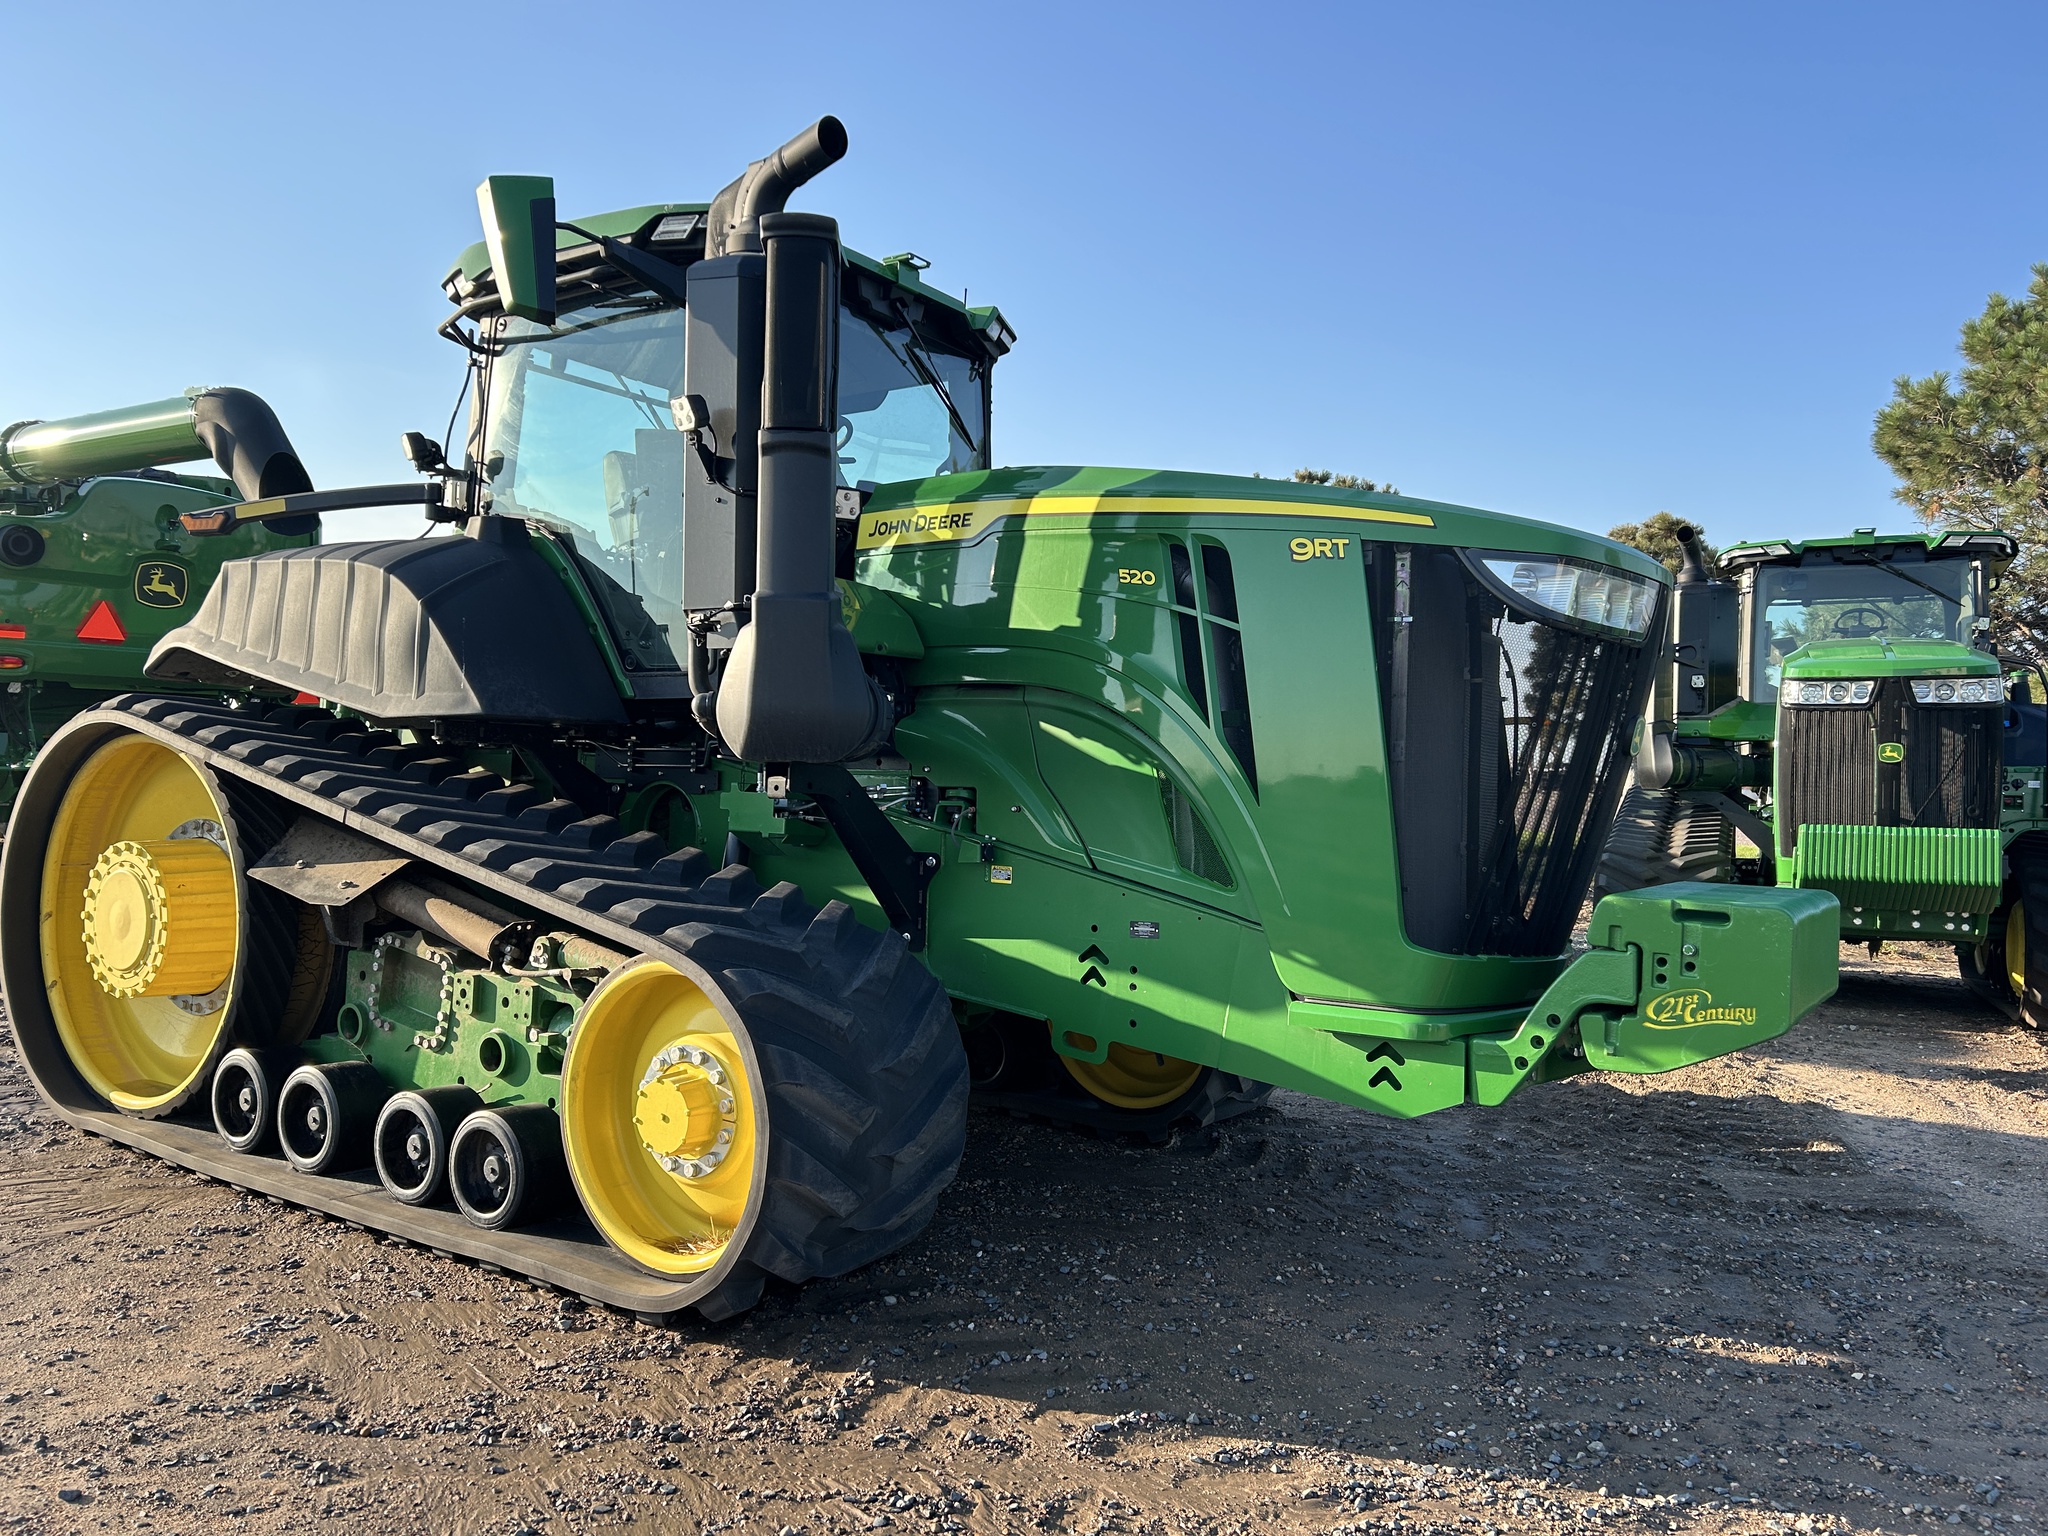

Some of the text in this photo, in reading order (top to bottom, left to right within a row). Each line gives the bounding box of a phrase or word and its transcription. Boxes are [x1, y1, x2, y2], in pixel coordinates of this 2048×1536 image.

[868, 512, 973, 537] JOHN DEERE
[1289, 537, 1350, 562] 9RT
[1118, 568, 1156, 585] 520
[1657, 993, 1699, 1022] 21st
